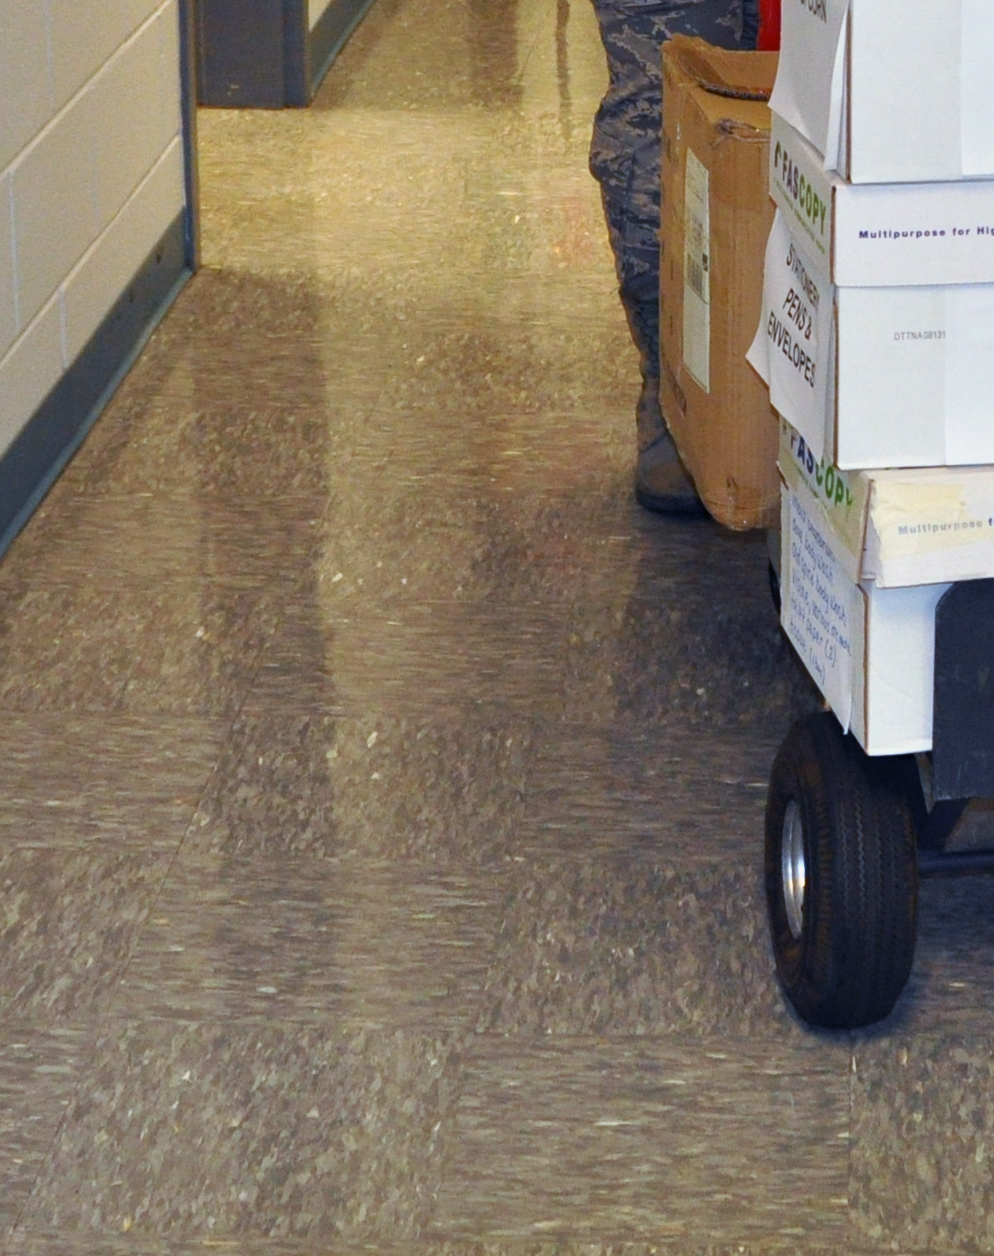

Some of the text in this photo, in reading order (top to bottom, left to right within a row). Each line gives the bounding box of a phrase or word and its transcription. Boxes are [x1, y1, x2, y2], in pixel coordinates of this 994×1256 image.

[782, 150, 827, 235] FASCOPY
[859, 229, 946, 240] Multipurpose
[952, 227, 971, 236] for
[782, 287, 807, 331] PENS
[767, 311, 815, 389] ENVELOPES
[898, 520, 983, 535] Multipurpose
